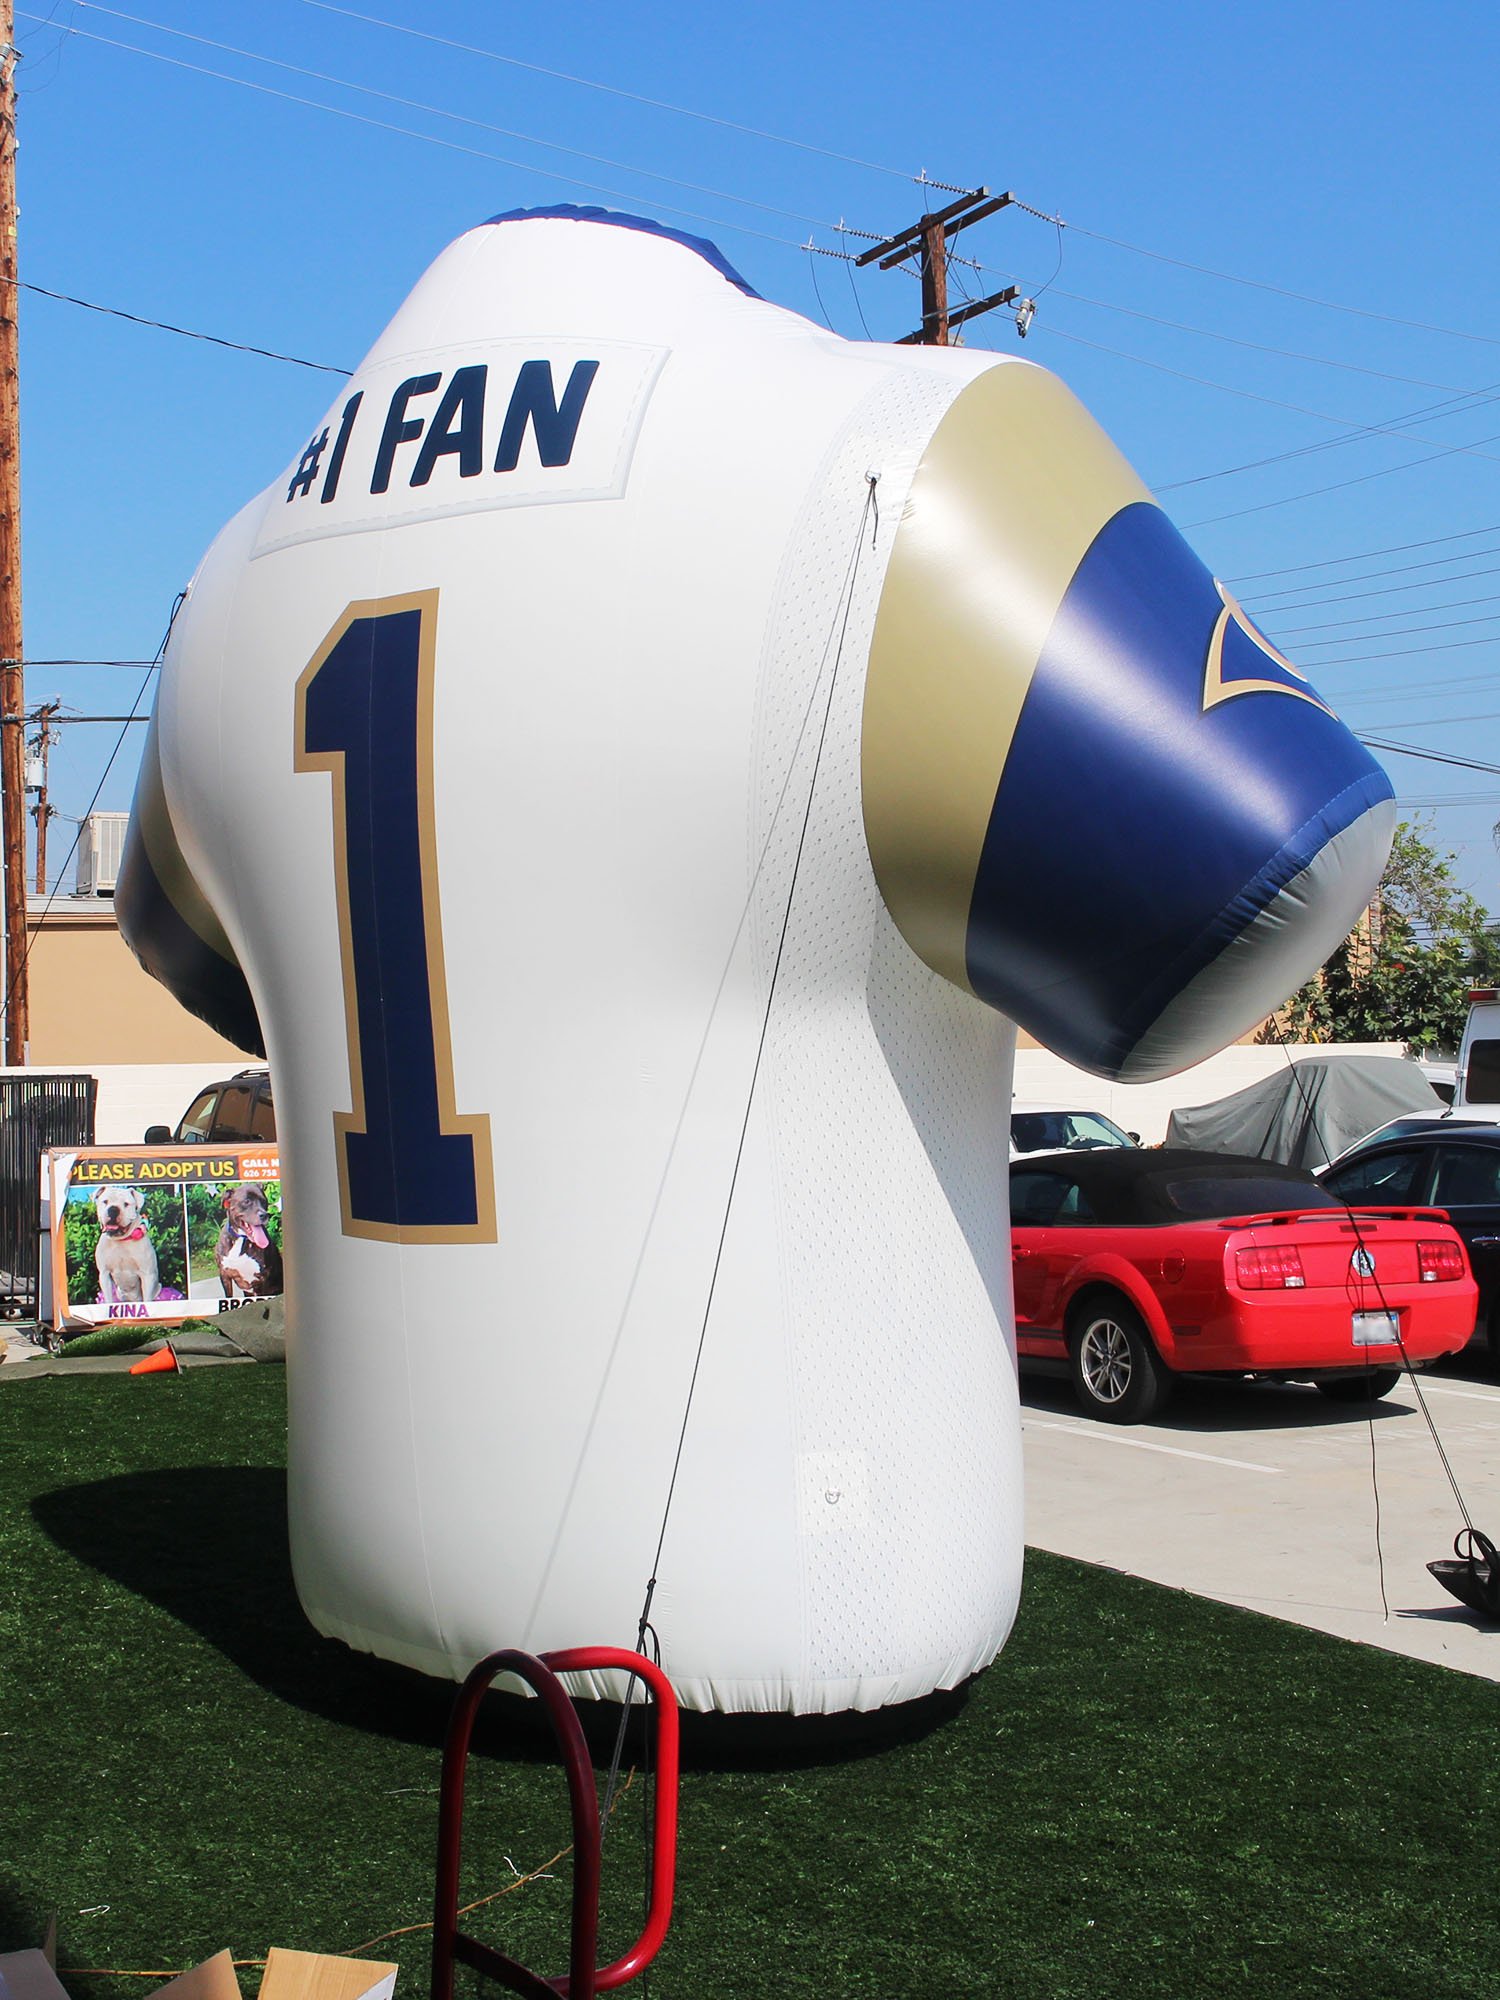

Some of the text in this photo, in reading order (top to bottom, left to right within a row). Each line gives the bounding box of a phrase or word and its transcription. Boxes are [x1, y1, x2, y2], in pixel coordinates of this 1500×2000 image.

[286, 360, 600, 504] #1 FAN
[294, 587, 498, 1243] 1
[138, 1161, 206, 1179] ADOPT
[209, 1160, 235, 1177] US
[242, 1158, 269, 1168] CALL
[243, 1169, 259, 1177] 626
[108, 1304, 149, 1318] KINA
